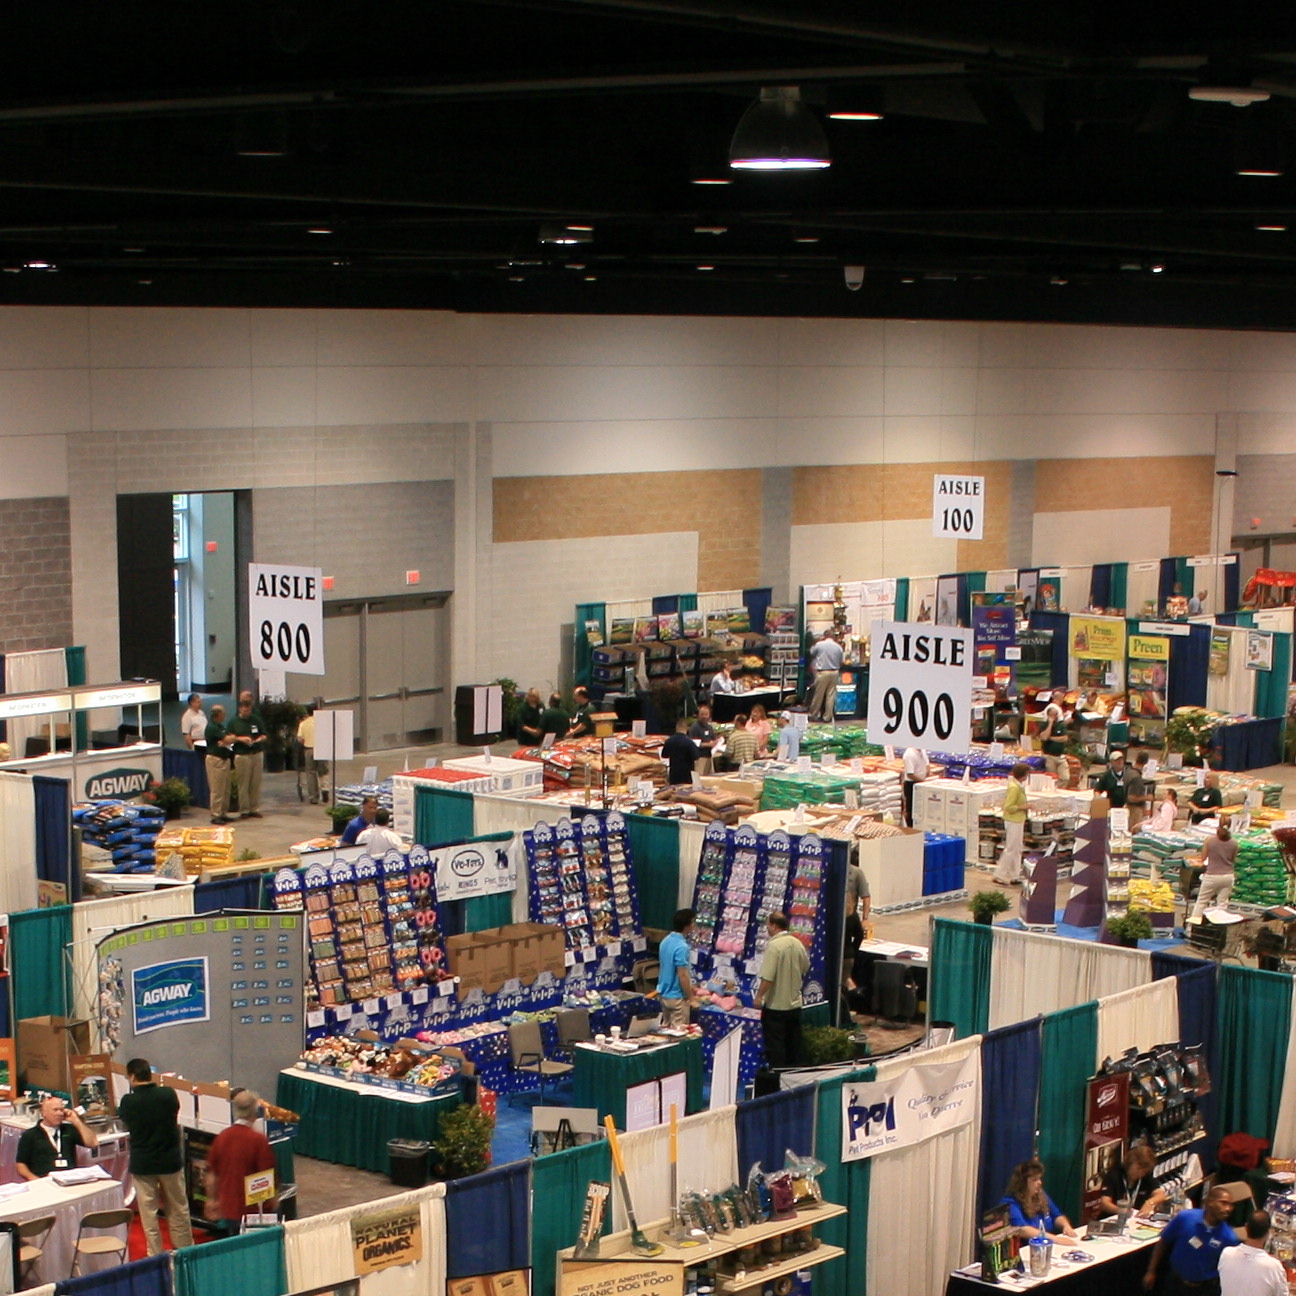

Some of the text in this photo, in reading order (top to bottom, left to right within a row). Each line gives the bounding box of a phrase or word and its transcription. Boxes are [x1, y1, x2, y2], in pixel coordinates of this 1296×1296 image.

[938, 480, 981, 497] AISLE
[942, 508, 974, 533] 100
[256, 573, 316, 601] AISLE
[260, 620, 311, 664] 800
[880, 632, 965, 667] AISLE
[1133, 638, 1163, 654] Preen
[883, 687, 954, 741] 900
[89, 773, 150, 797] AGWAY
[143, 983, 193, 1006] AGWAY
[355, 1217, 415, 1235] NATURAL
[355, 1222, 416, 1250] PLANET
[596, 1280, 615, 1289] JUST
[618, 1271, 657, 1283] ANOTHER
[617, 1282, 640, 1293] DOG
[644, 1274, 674, 1287] FOOD
